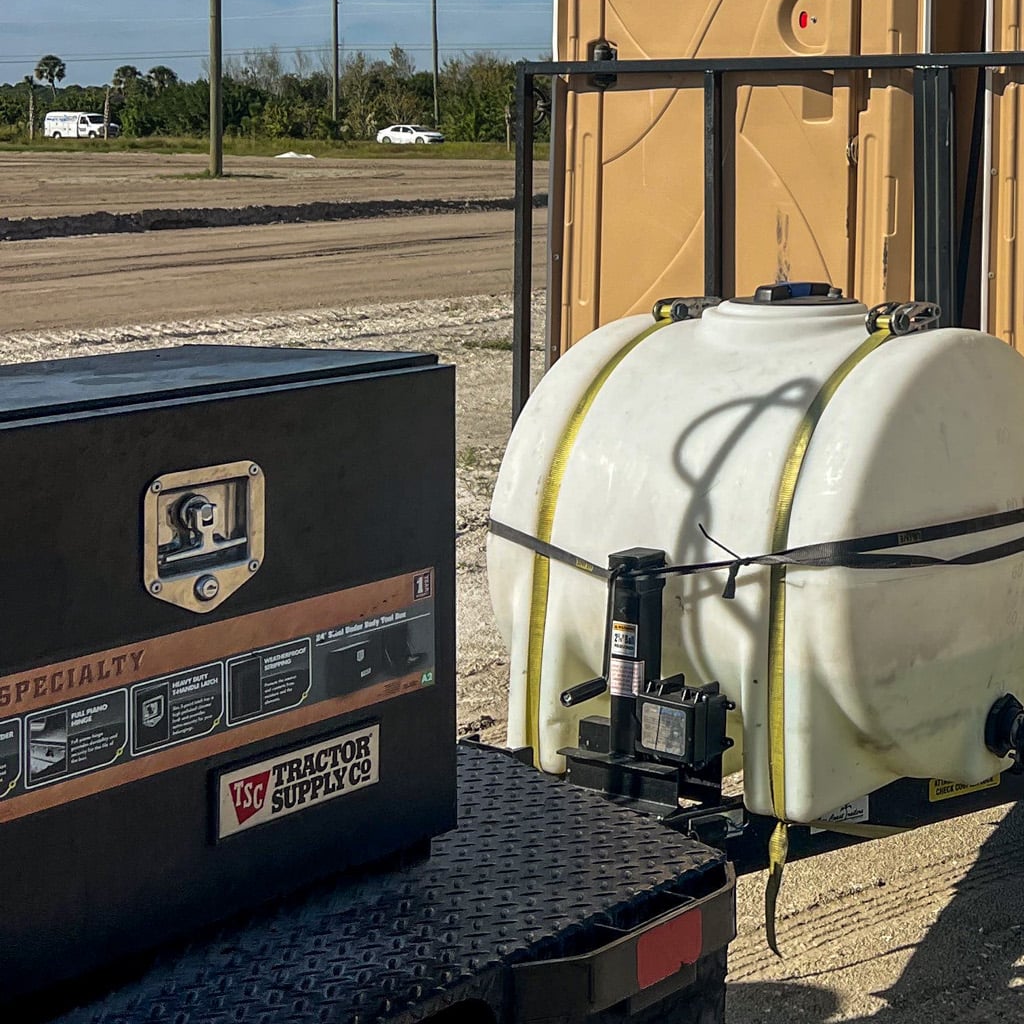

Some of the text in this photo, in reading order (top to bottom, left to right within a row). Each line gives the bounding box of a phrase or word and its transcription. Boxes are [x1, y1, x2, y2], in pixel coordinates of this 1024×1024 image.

[416, 576, 424, 594] 1
[0, 649, 145, 707] SPECIALTY
[172, 678, 192, 689] HEAVY
[201, 677, 219, 688] LATCH
[421, 672, 433, 684] A2
[71, 703, 109, 720] FULL PIANO
[71, 715, 93, 727] HINGE
[272, 735, 371, 788] TRACTOR
[233, 780, 264, 810] TSC
[271, 767, 348, 814] SUPPLY
[936, 787, 954, 796] CHECK
